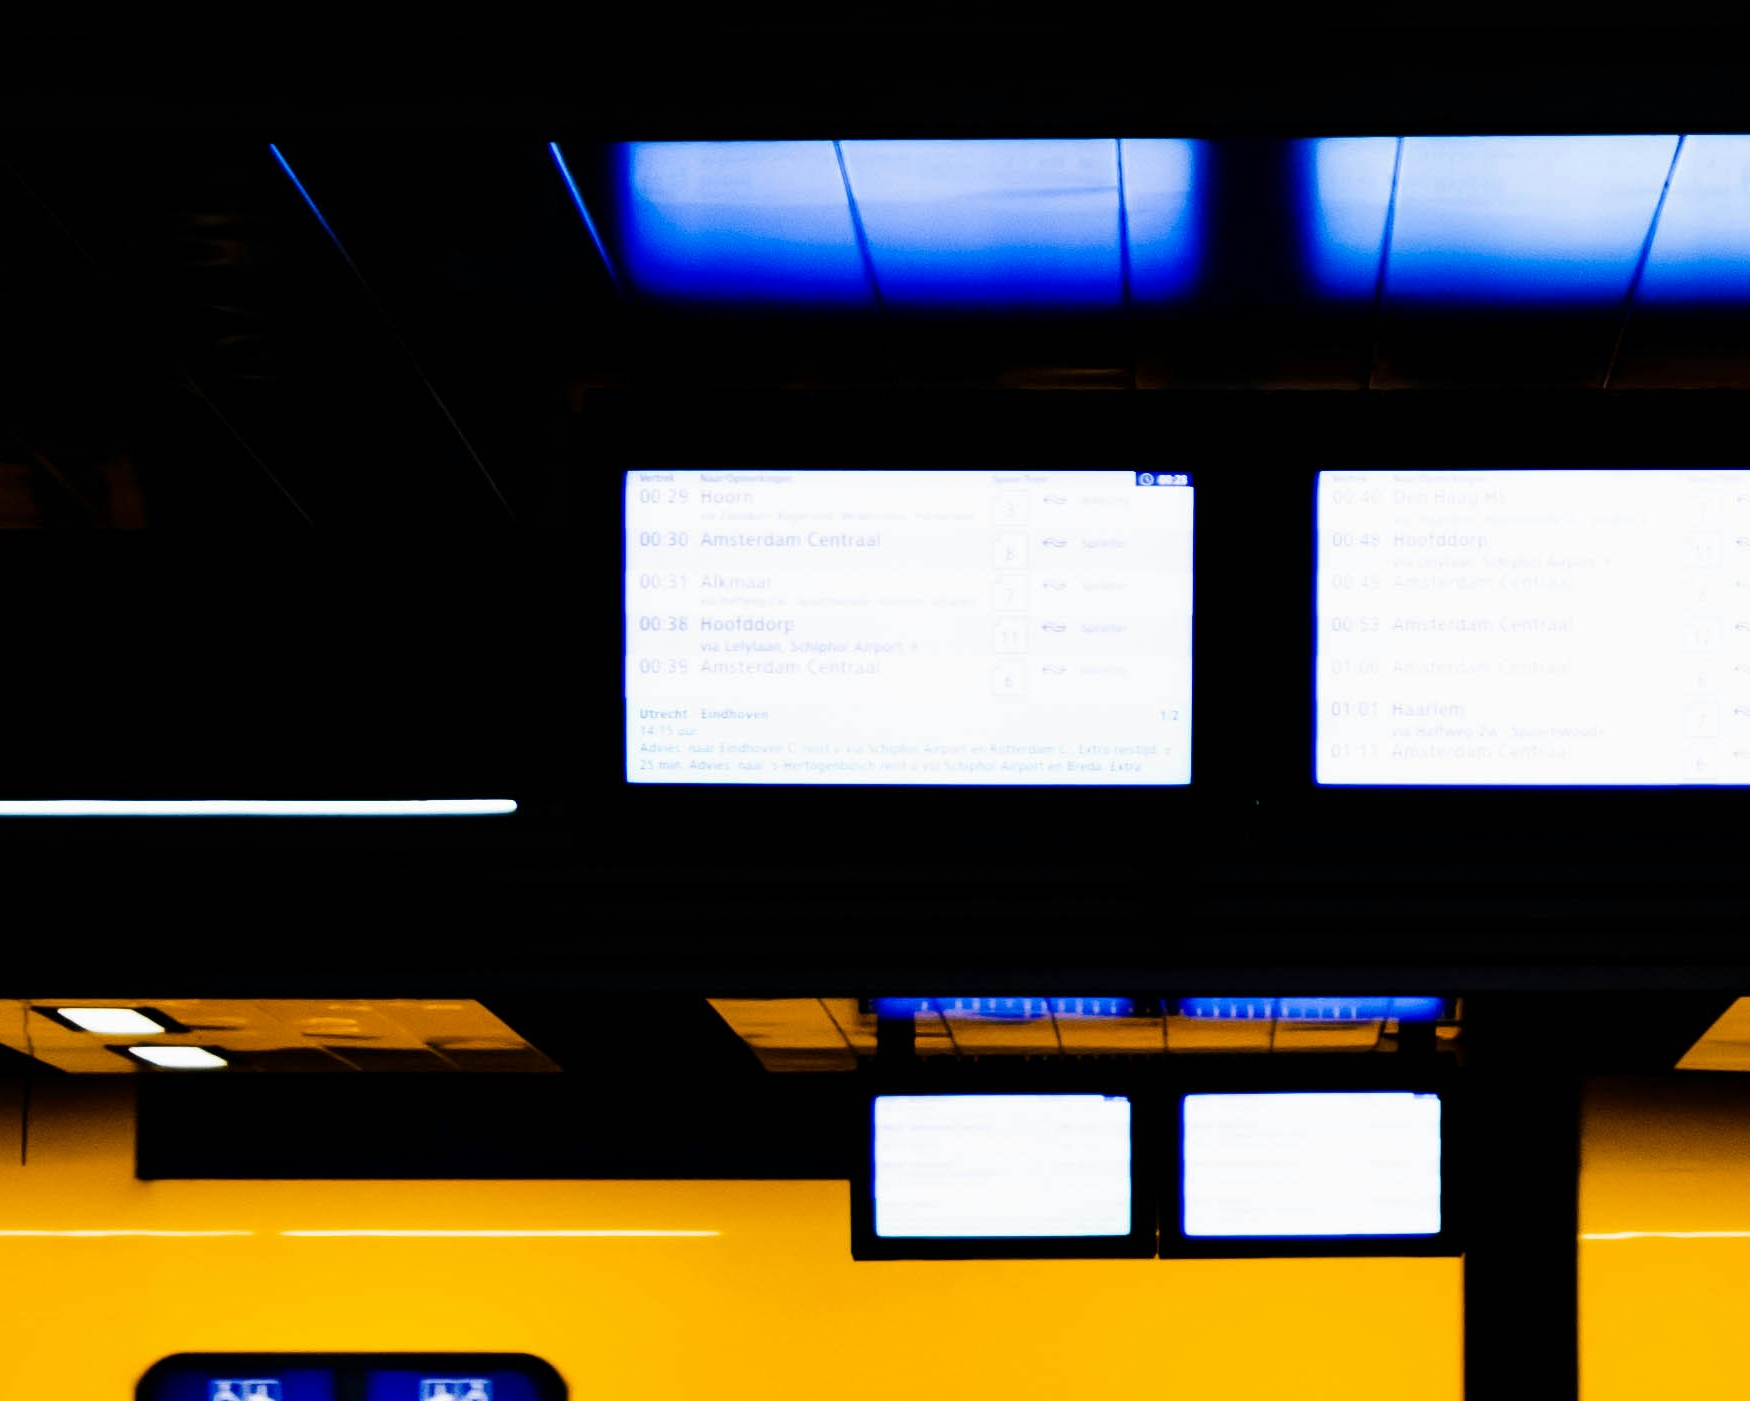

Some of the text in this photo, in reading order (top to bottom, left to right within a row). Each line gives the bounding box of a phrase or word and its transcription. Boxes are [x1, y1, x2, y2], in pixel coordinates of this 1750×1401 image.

[700, 489, 754, 504] Hoorn
[1394, 489, 1427, 504] Den
[639, 532, 881, 547] 00:30 Amsterdam Centraal
[1332, 532, 1487, 549] 00:48 Hoofddorp
[639, 574, 771, 590] 00:31 Alkmaar
[1394, 575, 1494, 590] Amsterdam
[1499, 575, 1573, 590] Centraal
[639, 616, 795, 634] 00:38 Hoofddorp
[1331, 617, 1574, 633] 00:53 Amsterdam Centraal
[639, 659, 881, 675] 00:39 Amsterdam Centraal
[1392, 659, 1491, 675] Amsterdam
[1498, 659, 1571, 675] Centraal
[639, 709, 769, 720] Utrecht Eindhoven
[1331, 702, 1466, 717] 01:01 Haarlem
[1331, 744, 1571, 760] 01:11 Amsterdam Centraal
